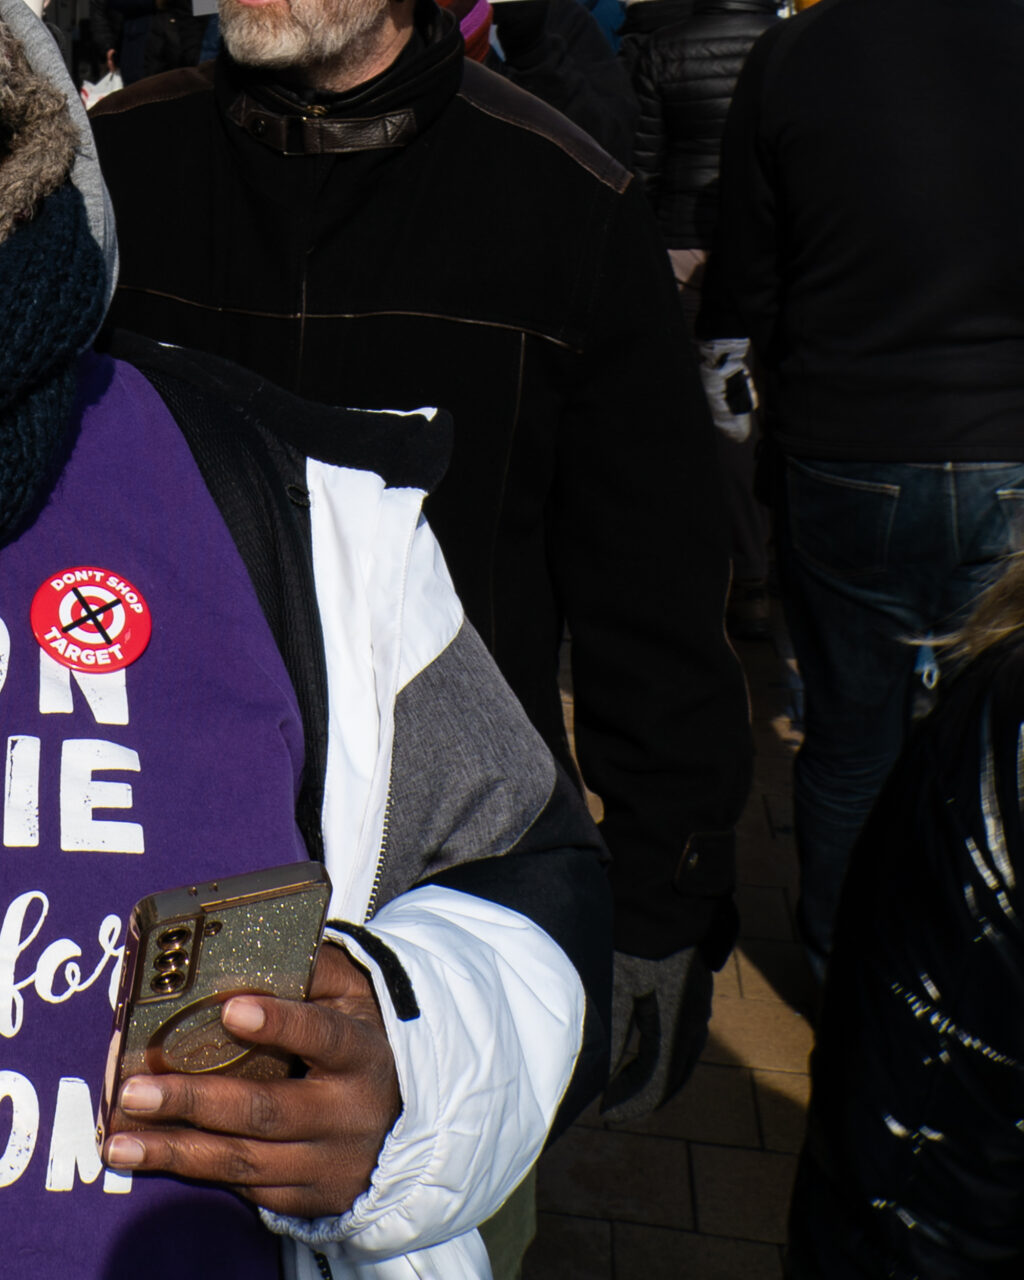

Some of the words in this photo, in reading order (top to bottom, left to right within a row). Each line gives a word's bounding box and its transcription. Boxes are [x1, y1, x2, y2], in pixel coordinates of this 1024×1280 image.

[50, 570, 104, 591] DON'T
[106, 576, 143, 613] SHOP
[43, 626, 123, 664] TARGET
